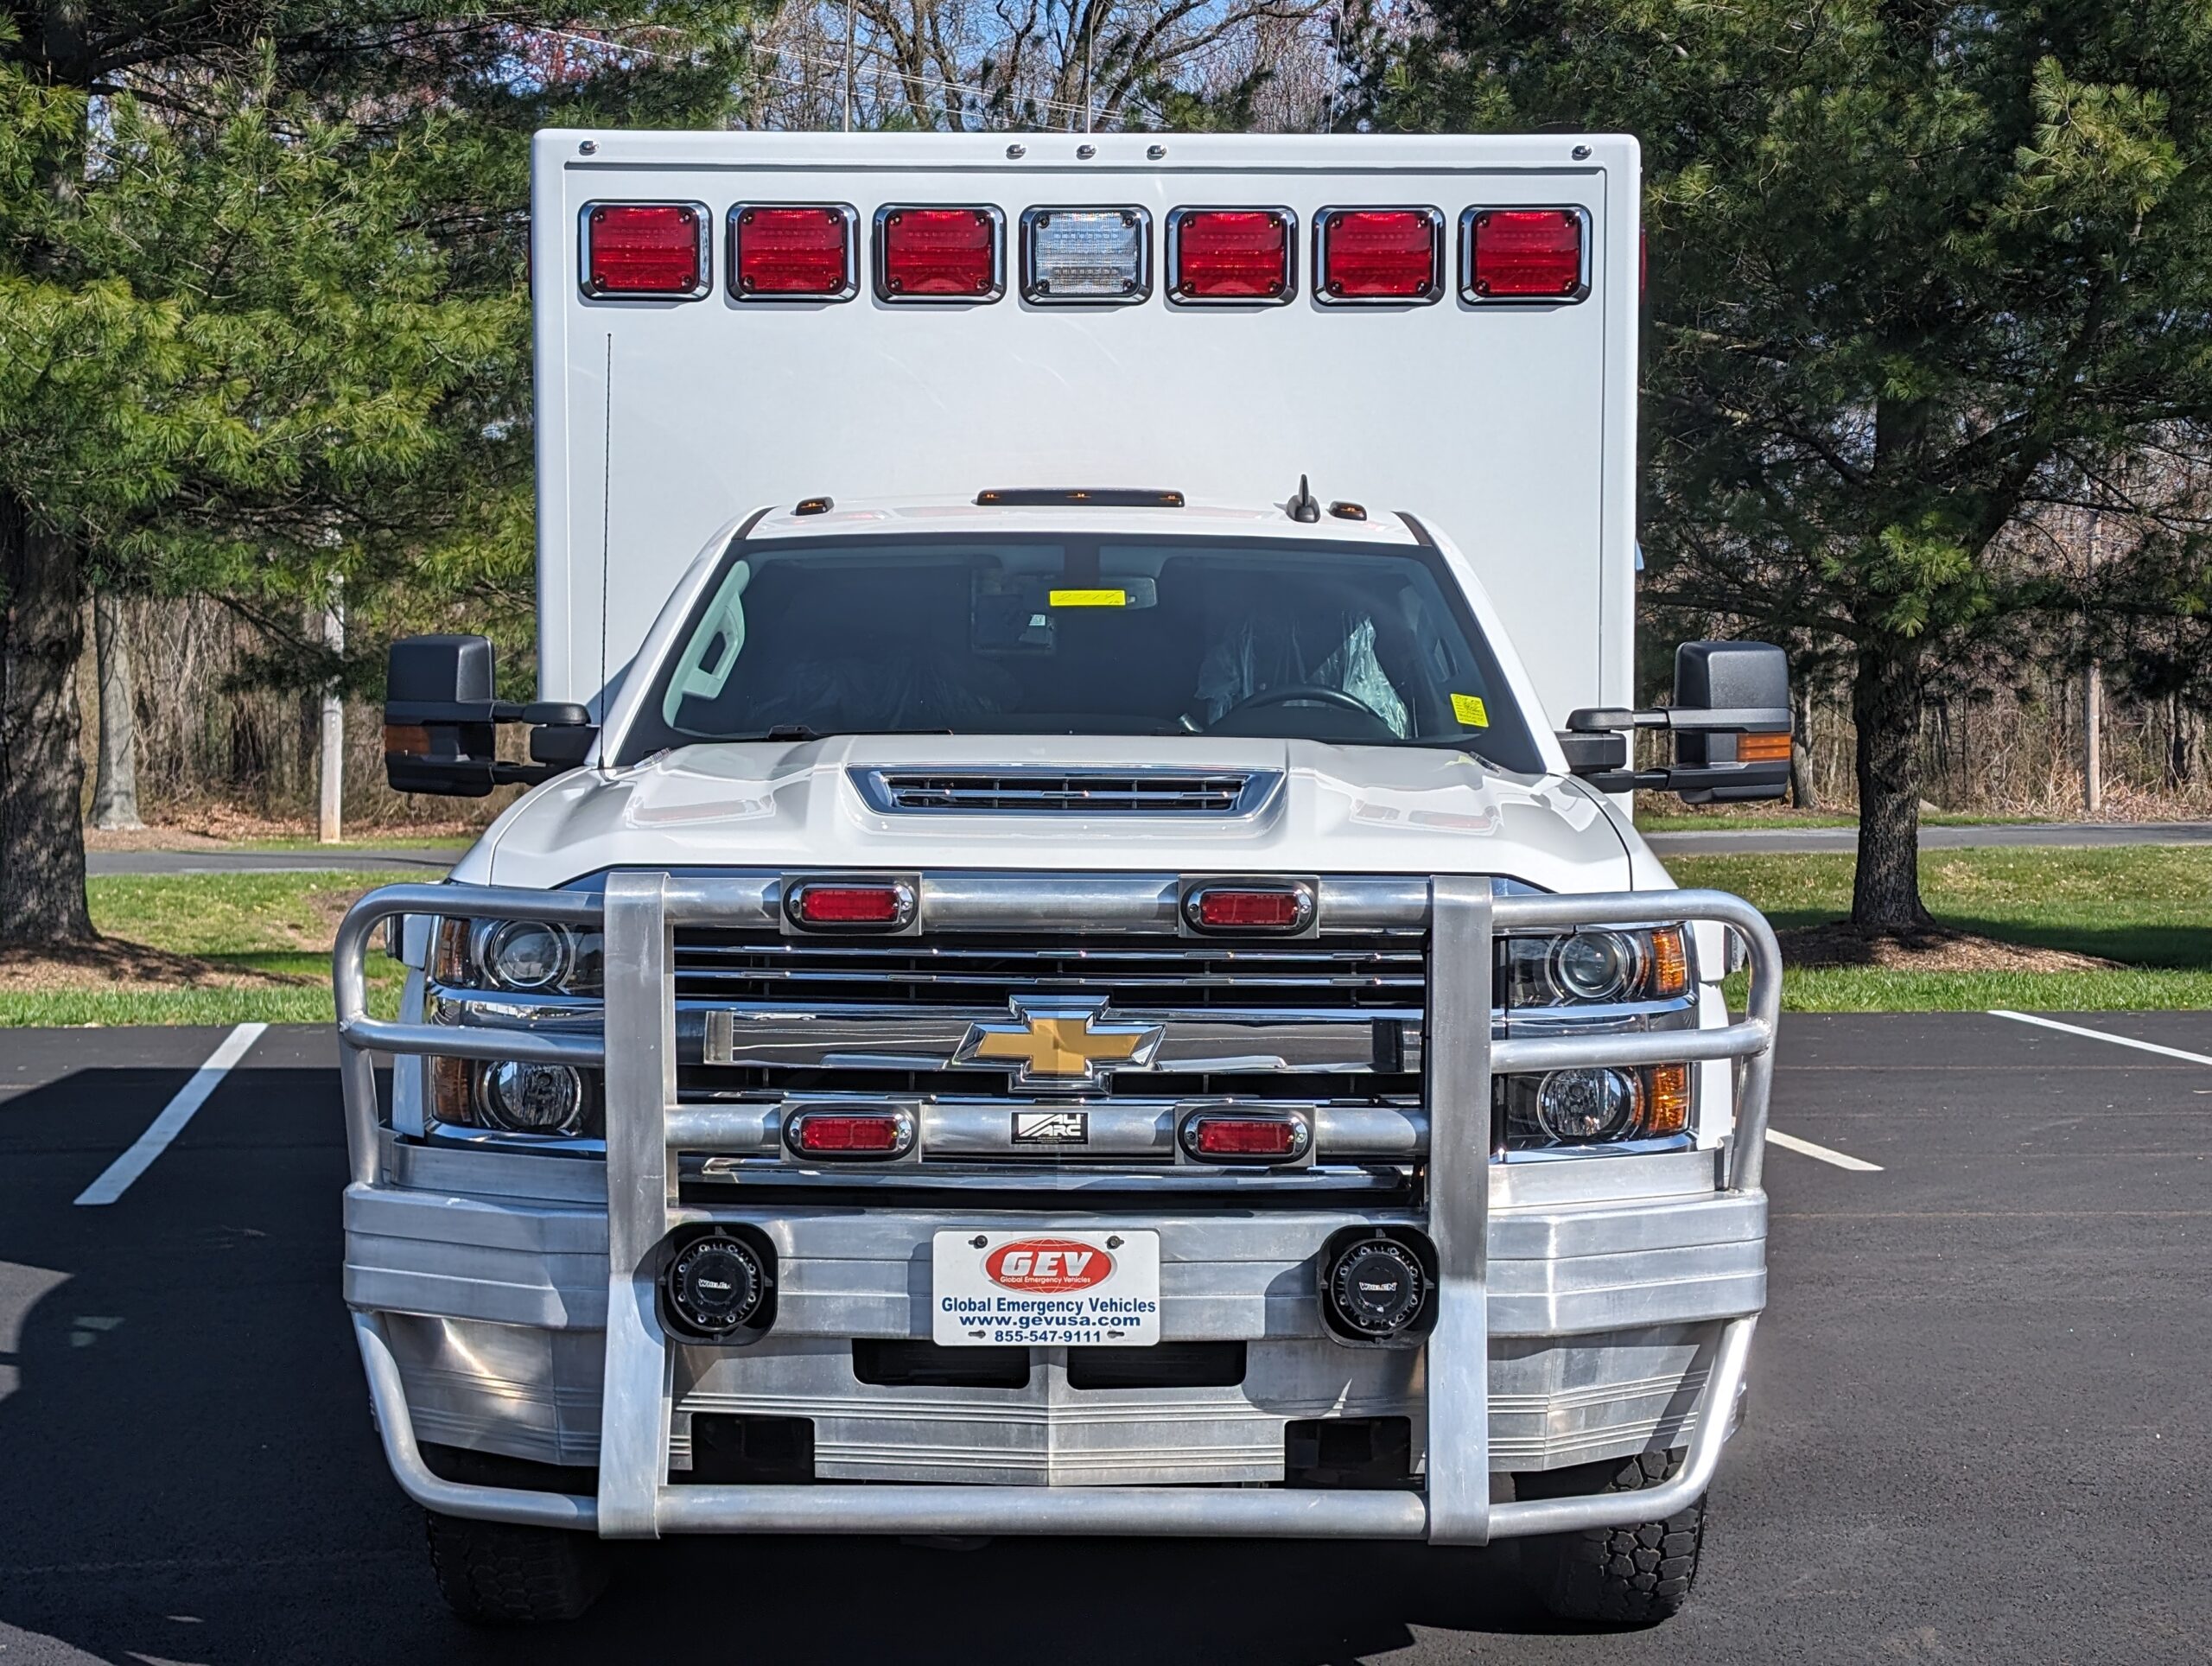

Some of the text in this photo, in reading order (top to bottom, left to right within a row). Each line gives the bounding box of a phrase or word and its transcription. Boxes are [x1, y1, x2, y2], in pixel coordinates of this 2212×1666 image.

[1034, 1124, 1081, 1136] ARC
[1001, 1251, 1093, 1276] GEV
[1358, 1281, 1397, 1291] WHELEN
[941, 1297, 1156, 1315] Global Emergency Vehicles
[959, 1315, 1141, 1329] www.gevusa.com
[995, 1330, 1101, 1343] 855-547-9111
